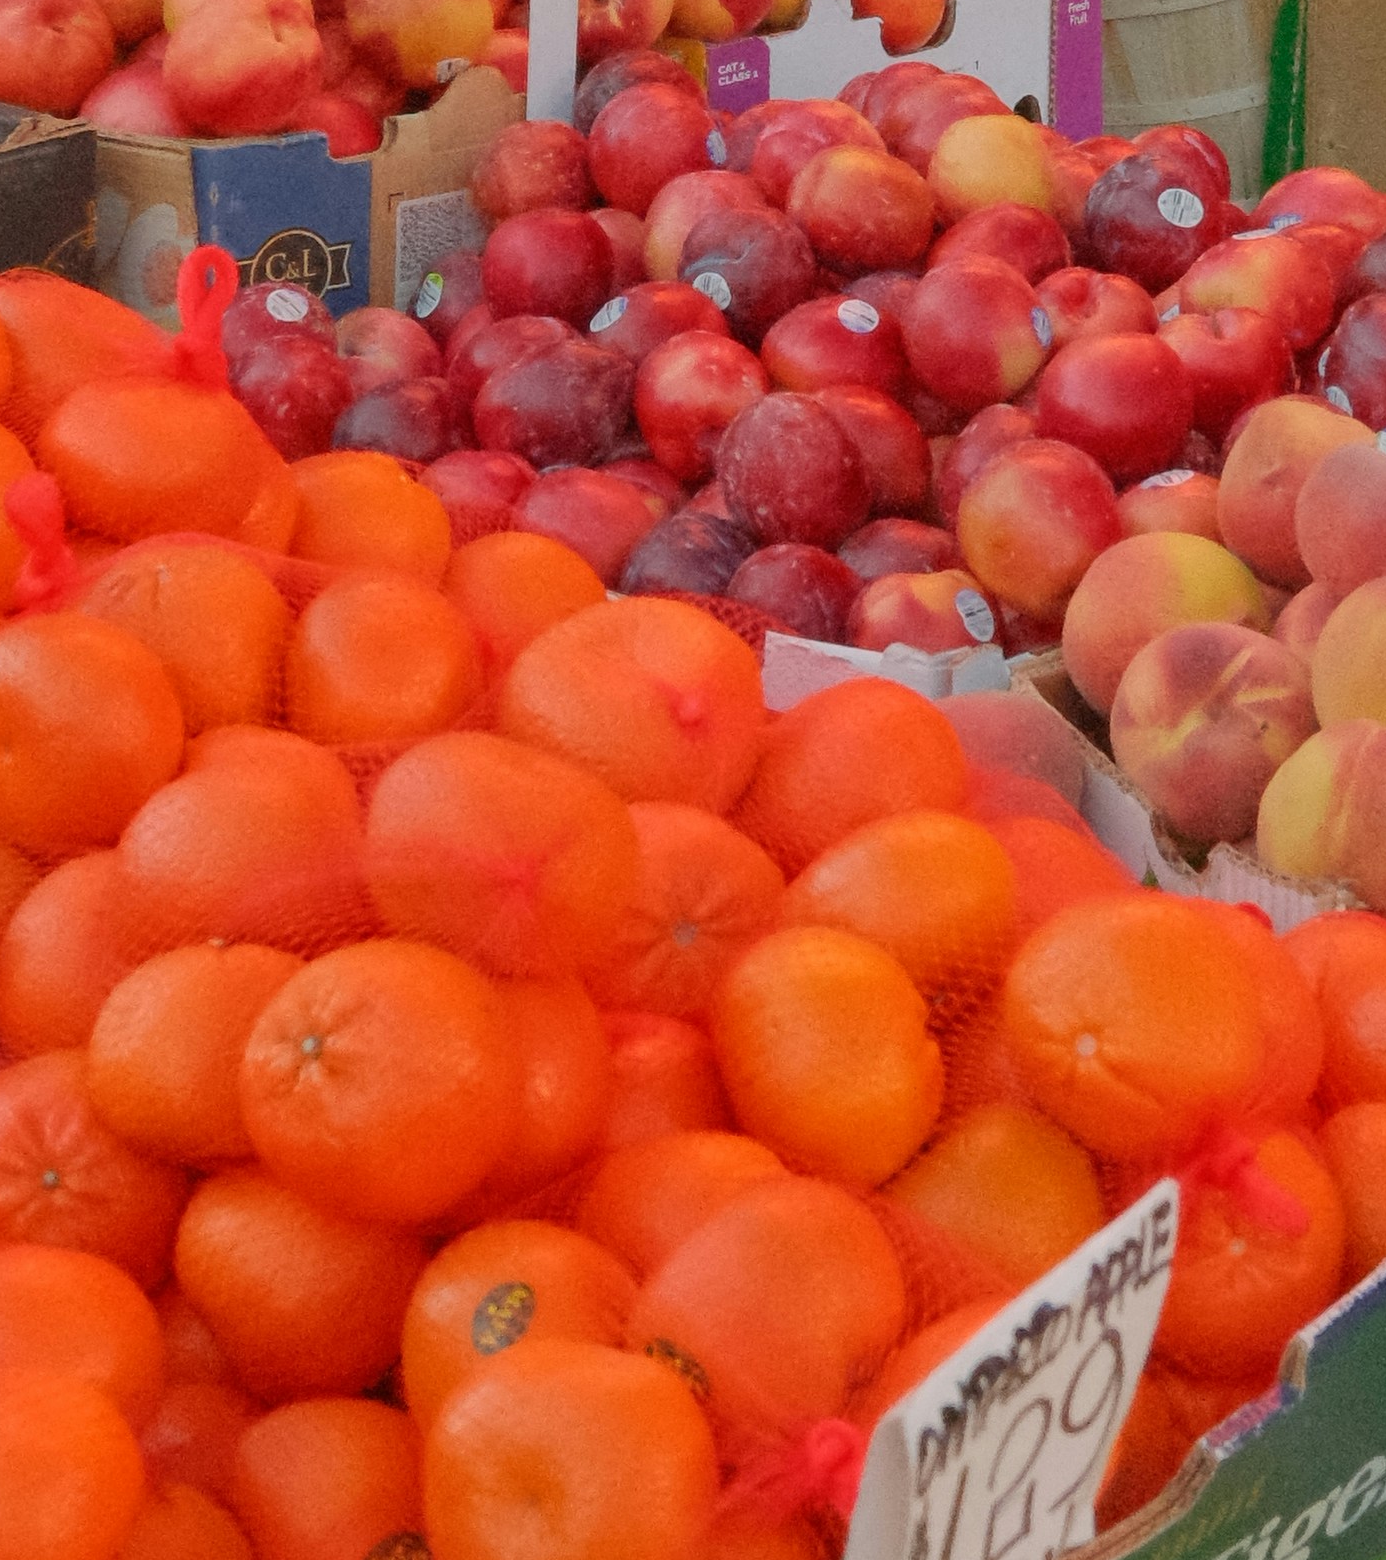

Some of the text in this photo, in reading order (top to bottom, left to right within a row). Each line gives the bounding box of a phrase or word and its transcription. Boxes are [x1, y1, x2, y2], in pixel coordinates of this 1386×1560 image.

[1068, 0, 1090, 13] Fresh
[1069, 12, 1088, 25] Fruit
[718, 62, 738, 74] CAT
[718, 71, 751, 86] CLASS
